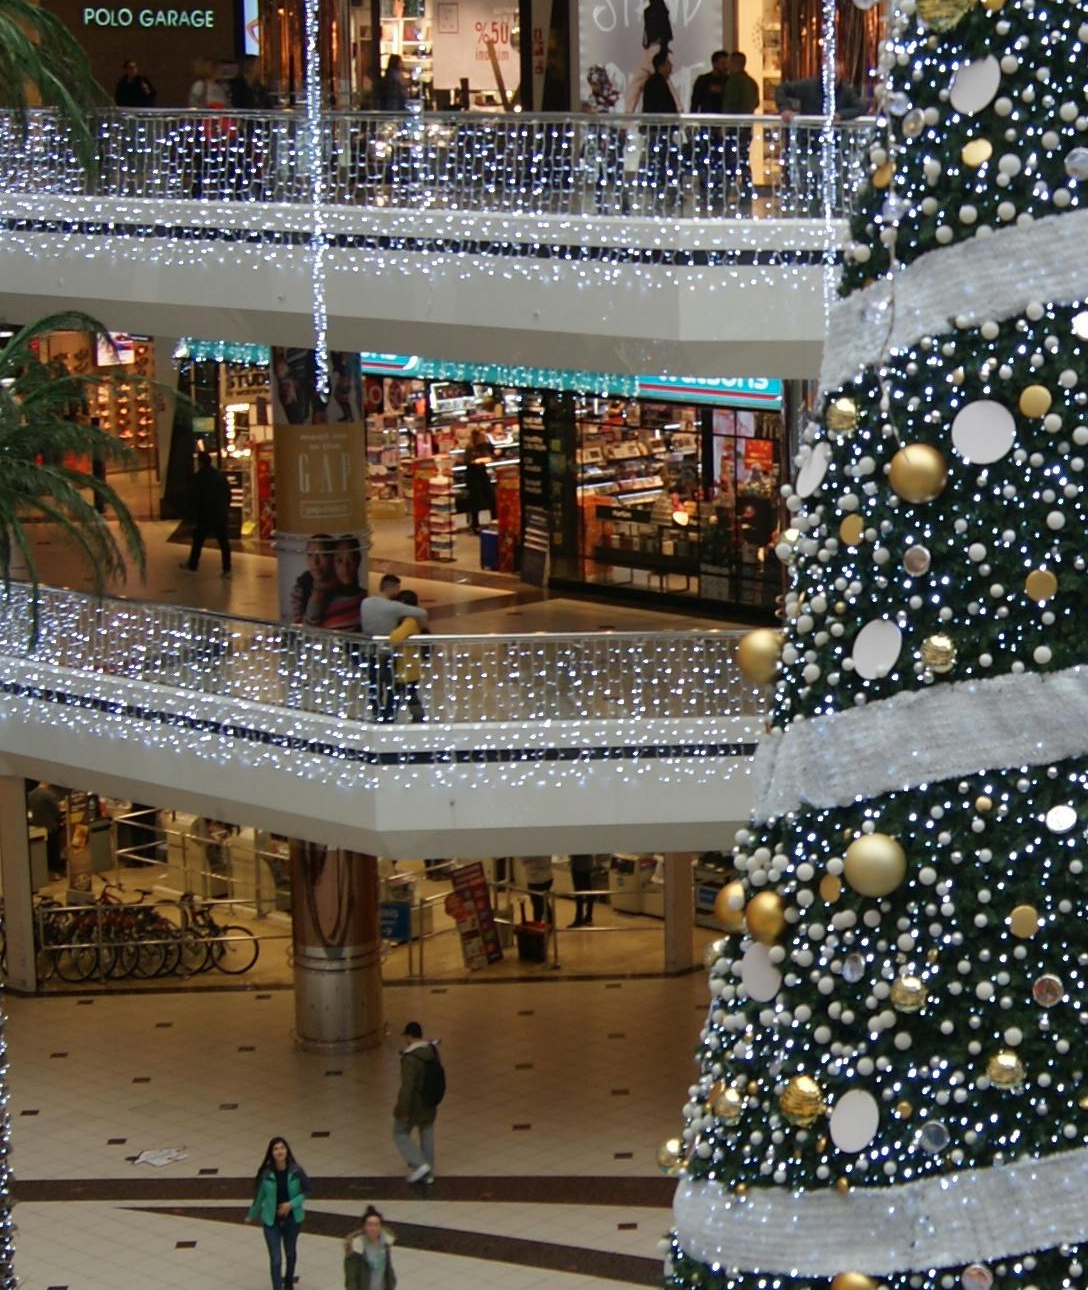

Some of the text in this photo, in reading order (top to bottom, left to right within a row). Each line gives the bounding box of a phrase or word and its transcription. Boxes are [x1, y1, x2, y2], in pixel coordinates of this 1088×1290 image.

[84, 8, 214, 28] POLO GARAGE
[299, 453, 352, 493] GAP
